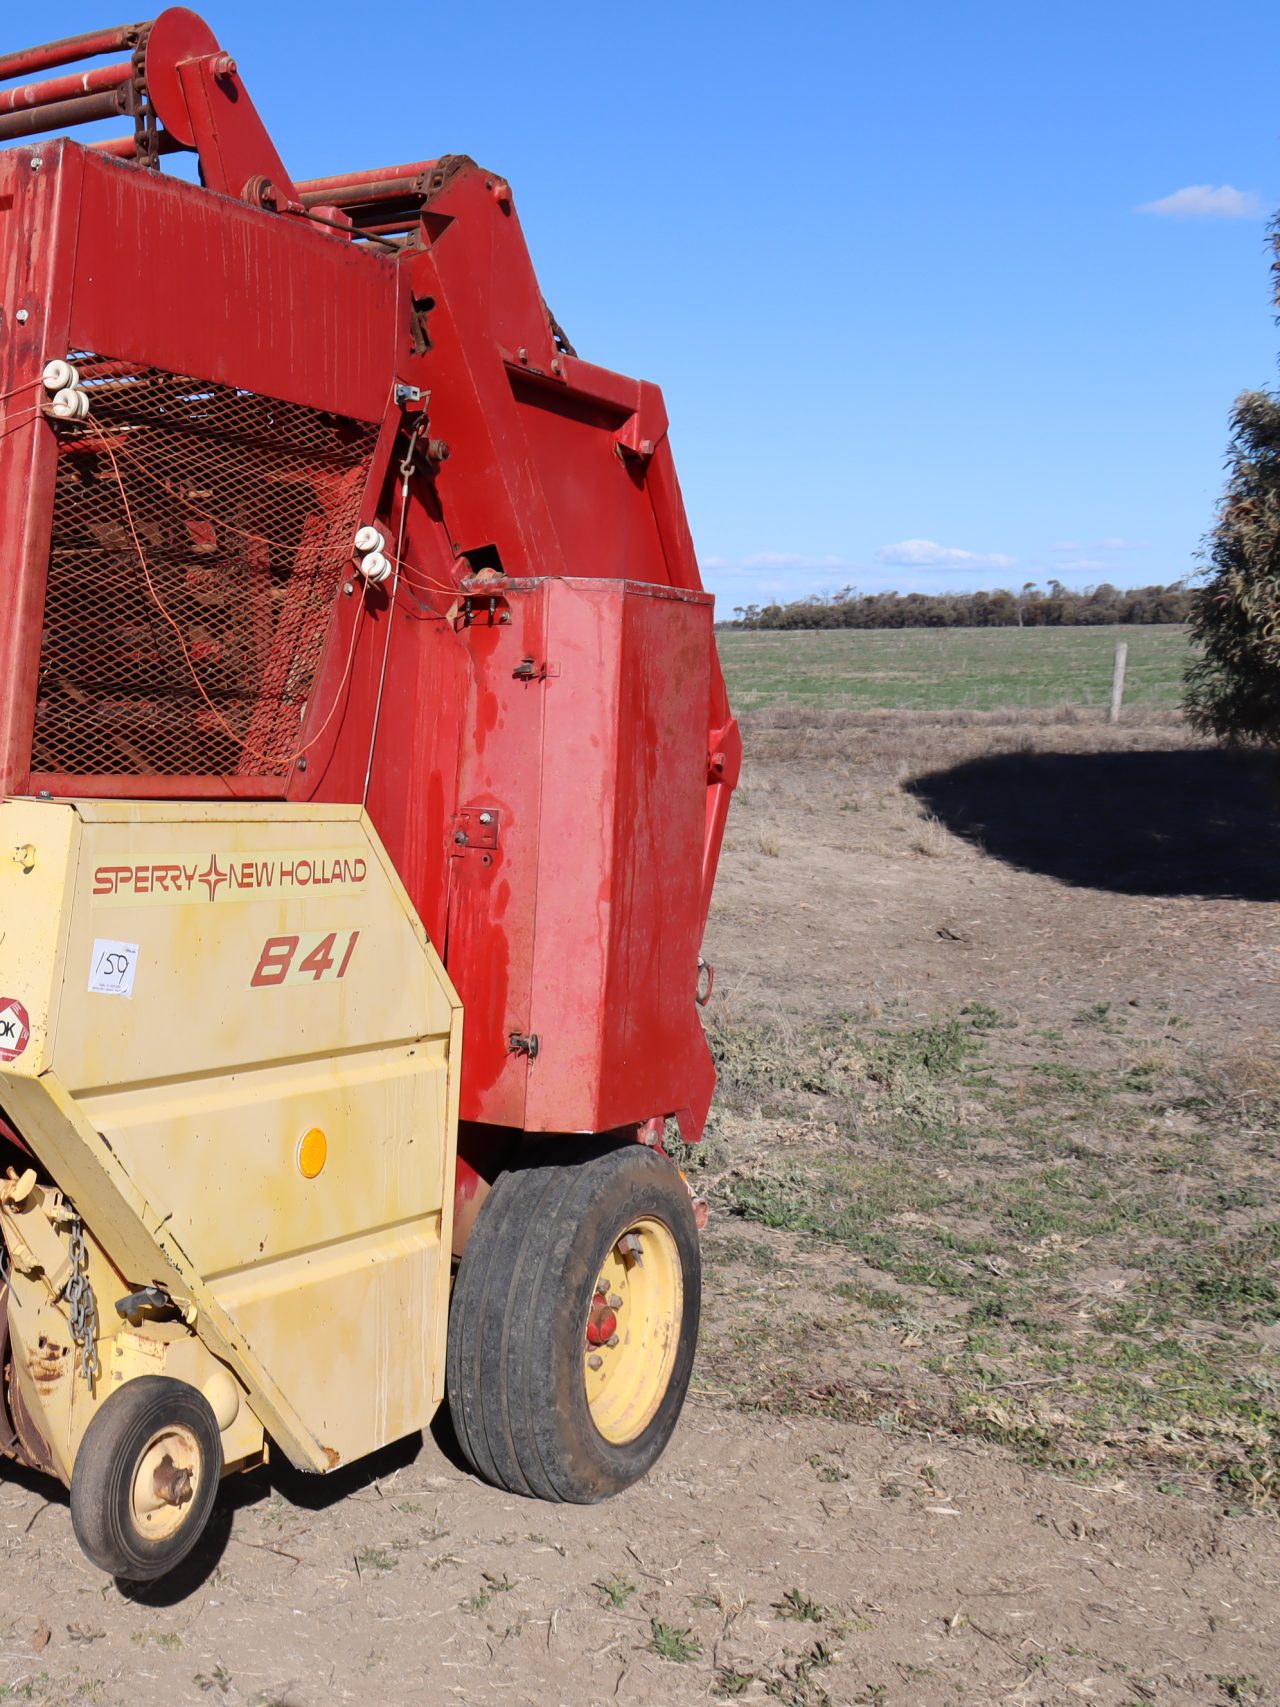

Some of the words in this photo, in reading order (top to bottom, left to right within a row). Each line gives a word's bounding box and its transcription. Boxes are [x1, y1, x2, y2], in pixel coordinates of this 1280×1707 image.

[93, 864, 197, 894] SPERRY
[229, 862, 275, 889] NEW
[280, 858, 367, 886] HOLLAND
[95, 951, 129, 984] 159
[250, 931, 360, 987] 841
